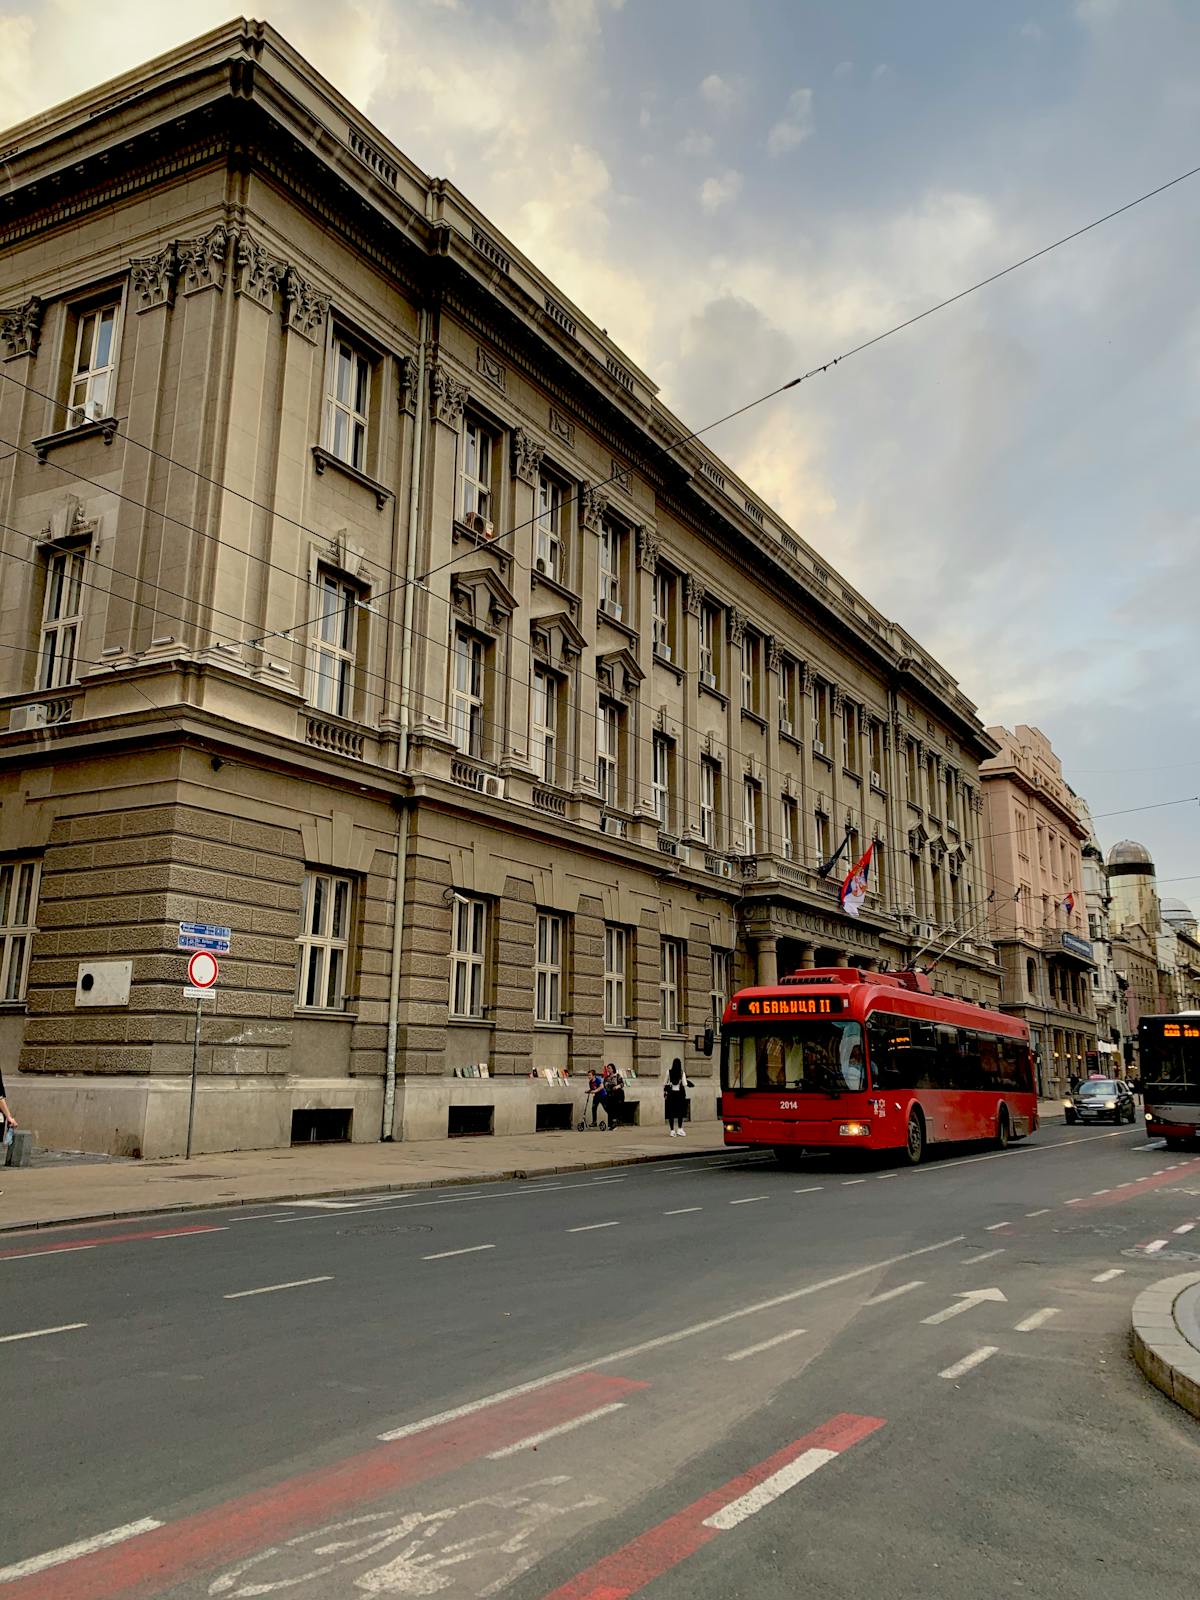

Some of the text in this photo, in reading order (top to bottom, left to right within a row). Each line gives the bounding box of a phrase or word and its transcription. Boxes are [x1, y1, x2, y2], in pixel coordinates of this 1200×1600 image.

[763, 1000, 816, 1014] БАЊИЦА
[819, 999, 831, 1013] II
[780, 1101, 798, 1109] 2014
